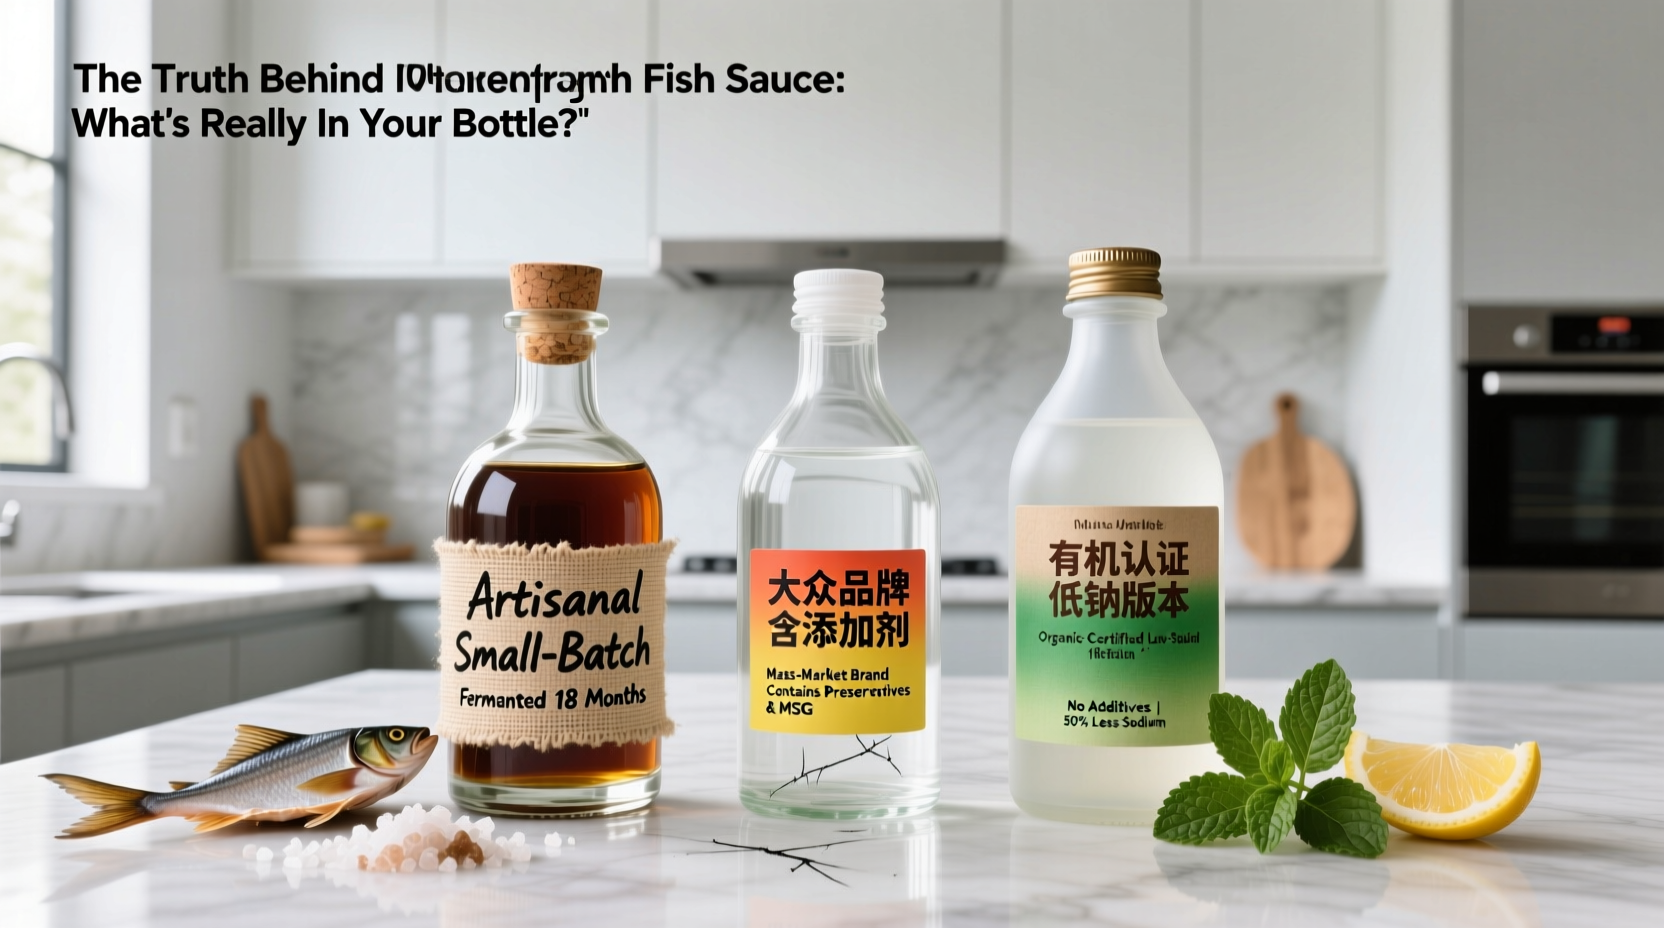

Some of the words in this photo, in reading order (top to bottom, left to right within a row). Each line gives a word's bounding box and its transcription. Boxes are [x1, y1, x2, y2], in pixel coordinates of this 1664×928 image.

[1048, 539, 1190, 577] 有机认证
[466, 568, 644, 620] Artisanal
[768, 568, 910, 607] 大众品牌
[1048, 580, 1190, 619] 低钠版本
[768, 610, 909, 648] 含添加剂
[454, 625, 650, 673] Small-Batch
[850, 666, 889, 681] Brand
[554, 687, 579, 710] 18
[584, 682, 647, 709] Months
[765, 700, 776, 715] &
[779, 701, 813, 715] MSG
[766, 684, 821, 698] Contains
[1067, 699, 1085, 712] No
[1087, 700, 1152, 713] Additives
[1063, 715, 1089, 728] 50%
[1092, 716, 1120, 729] Less
